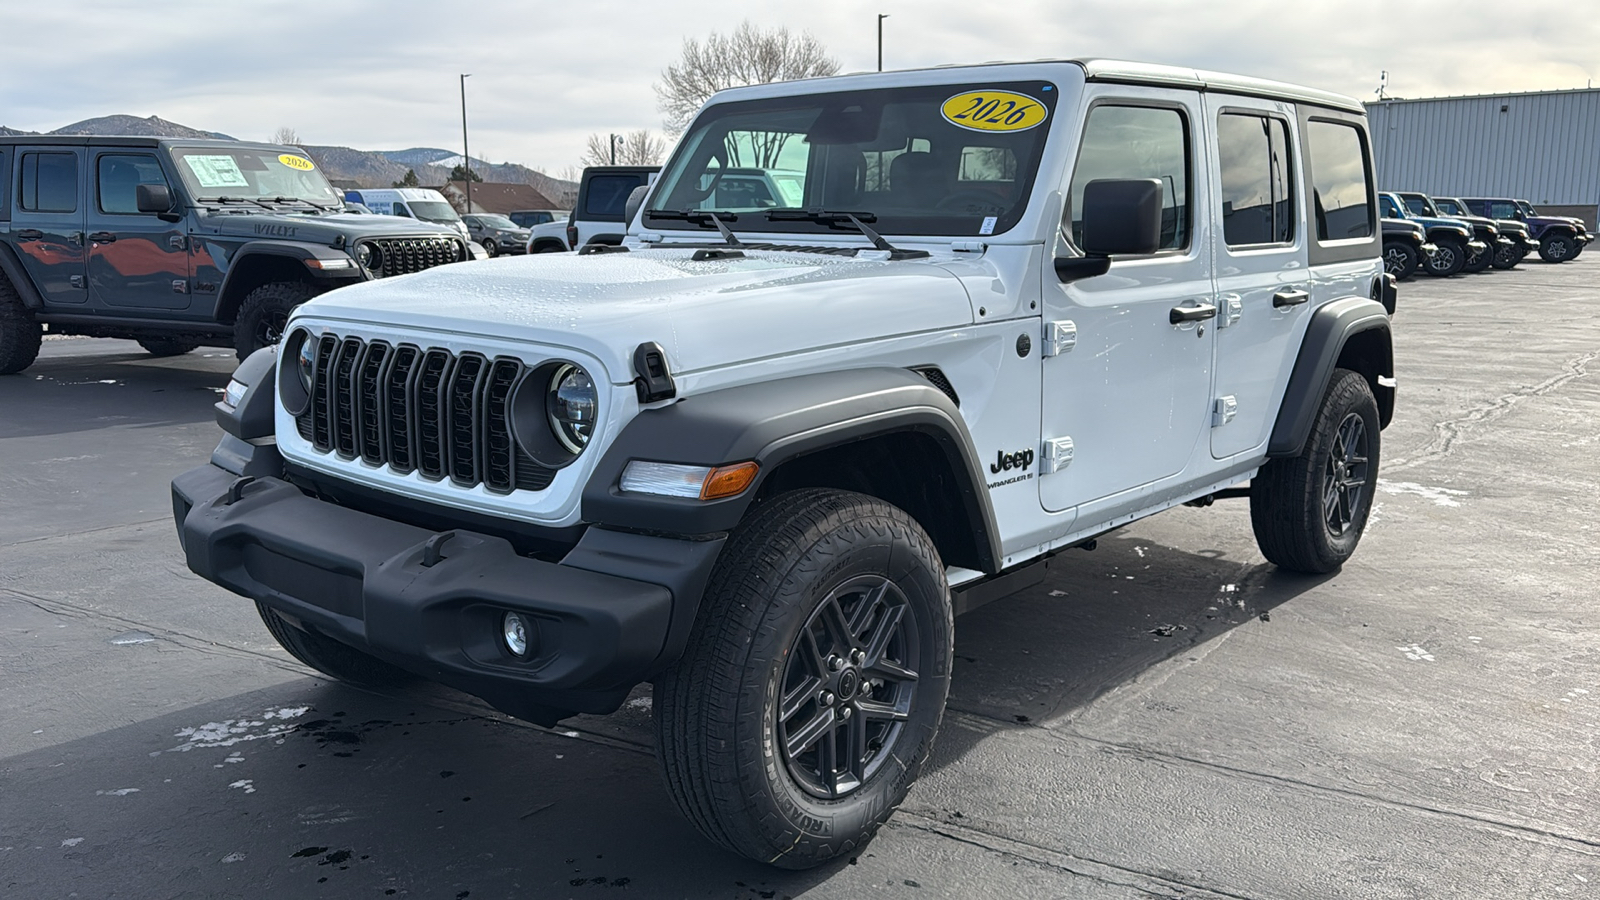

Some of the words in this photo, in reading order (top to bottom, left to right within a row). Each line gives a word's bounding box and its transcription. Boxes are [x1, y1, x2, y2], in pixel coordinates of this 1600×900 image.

[953, 97, 1037, 126] 2026
[285, 156, 309, 169] 2026
[254, 223, 299, 237] WILLYS
[194, 281, 215, 292] Jeep
[991, 448, 1034, 474] Jeep
[987, 474, 1026, 489] WRANGLER
